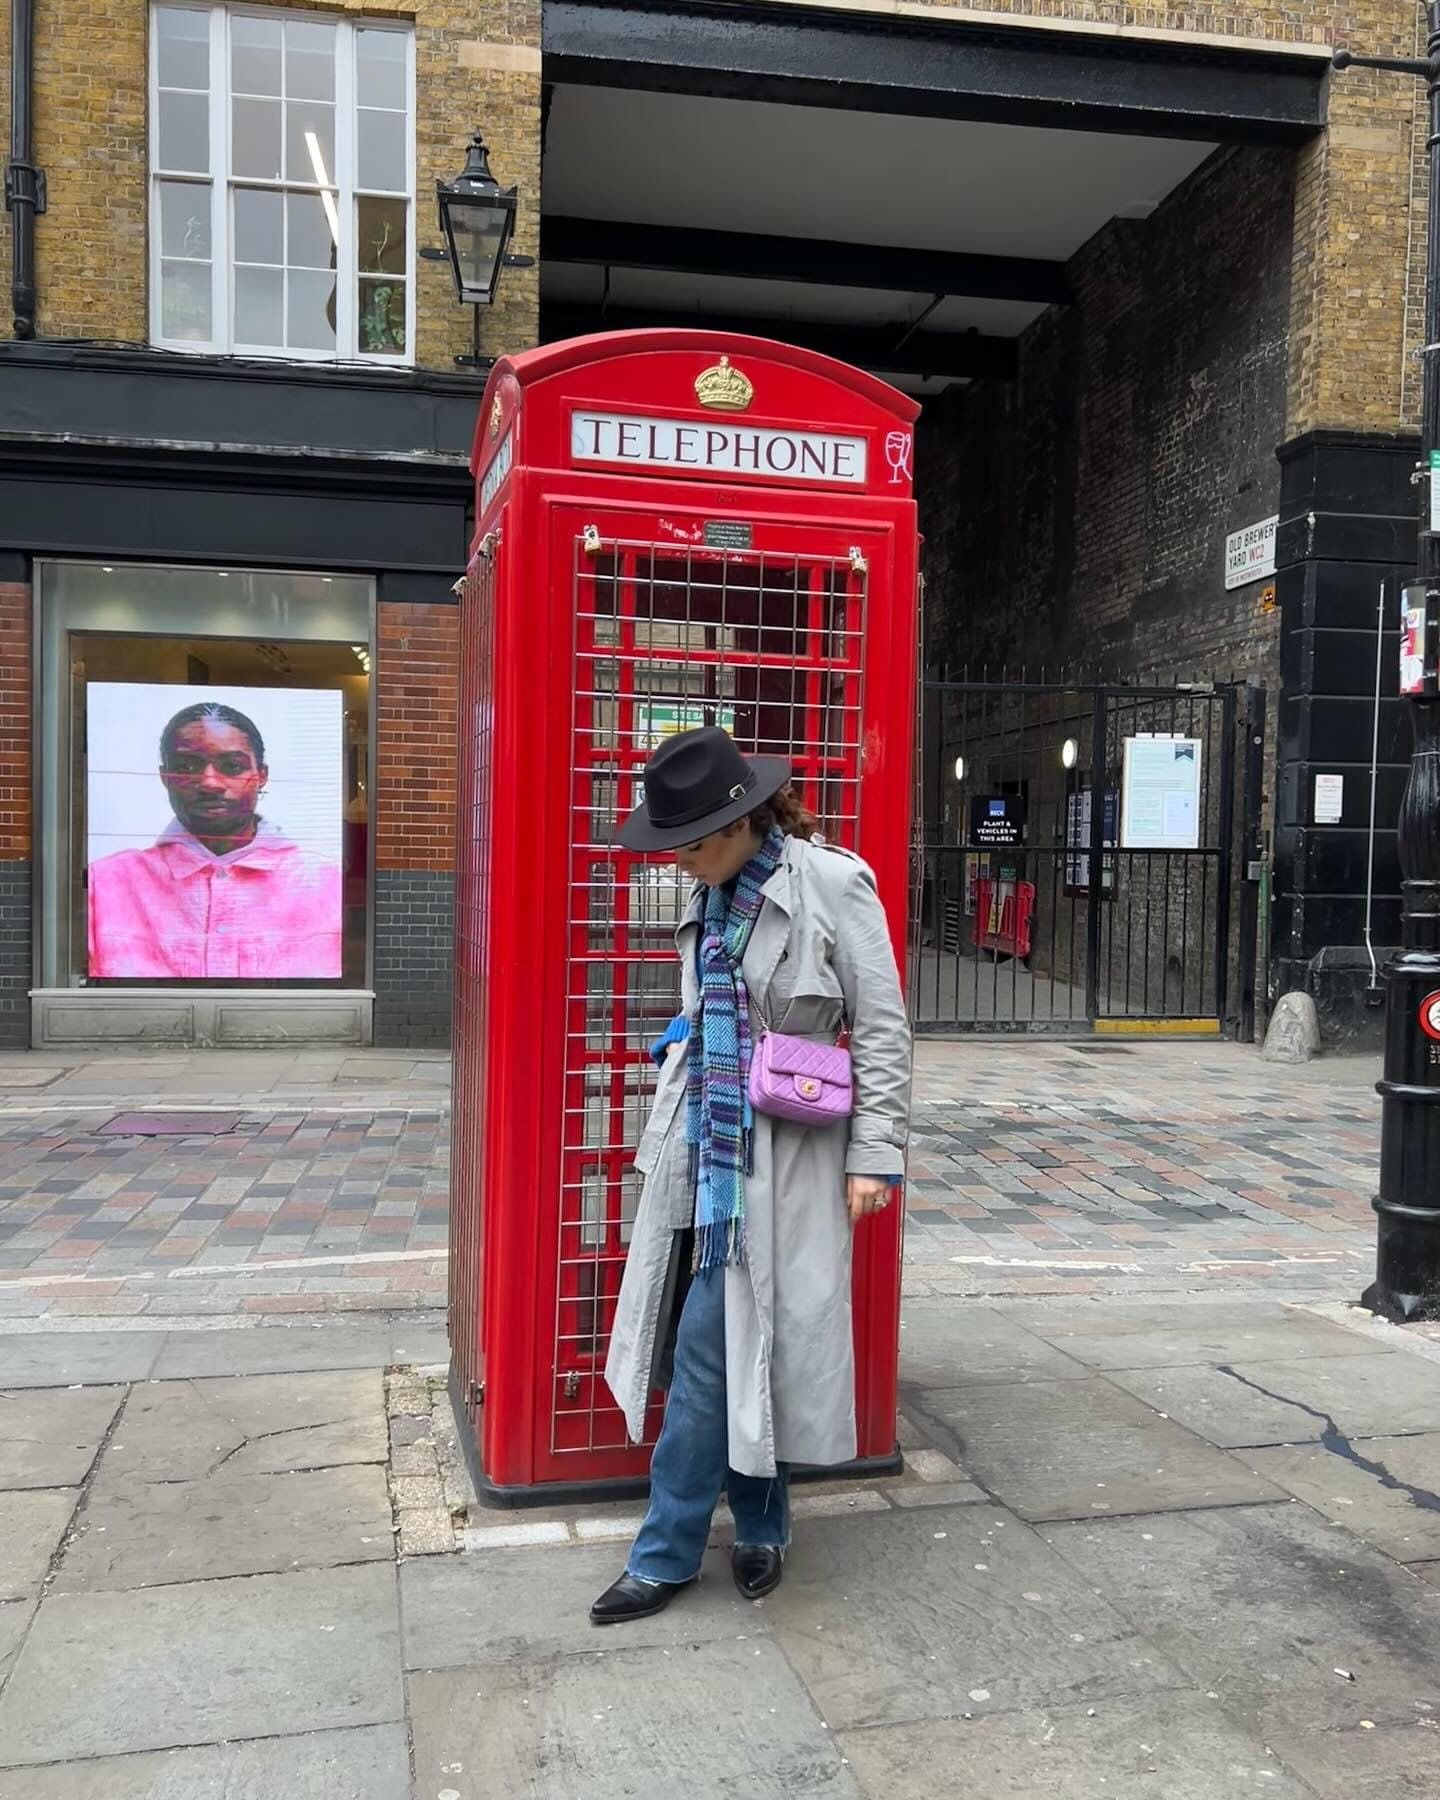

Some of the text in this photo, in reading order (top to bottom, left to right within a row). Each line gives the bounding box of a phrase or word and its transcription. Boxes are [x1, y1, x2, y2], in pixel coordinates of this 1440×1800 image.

[583, 418, 856, 477] TELEPHONE
[1229, 535, 1242, 553] OLD
[1229, 544, 1264, 570] YARD WC2
